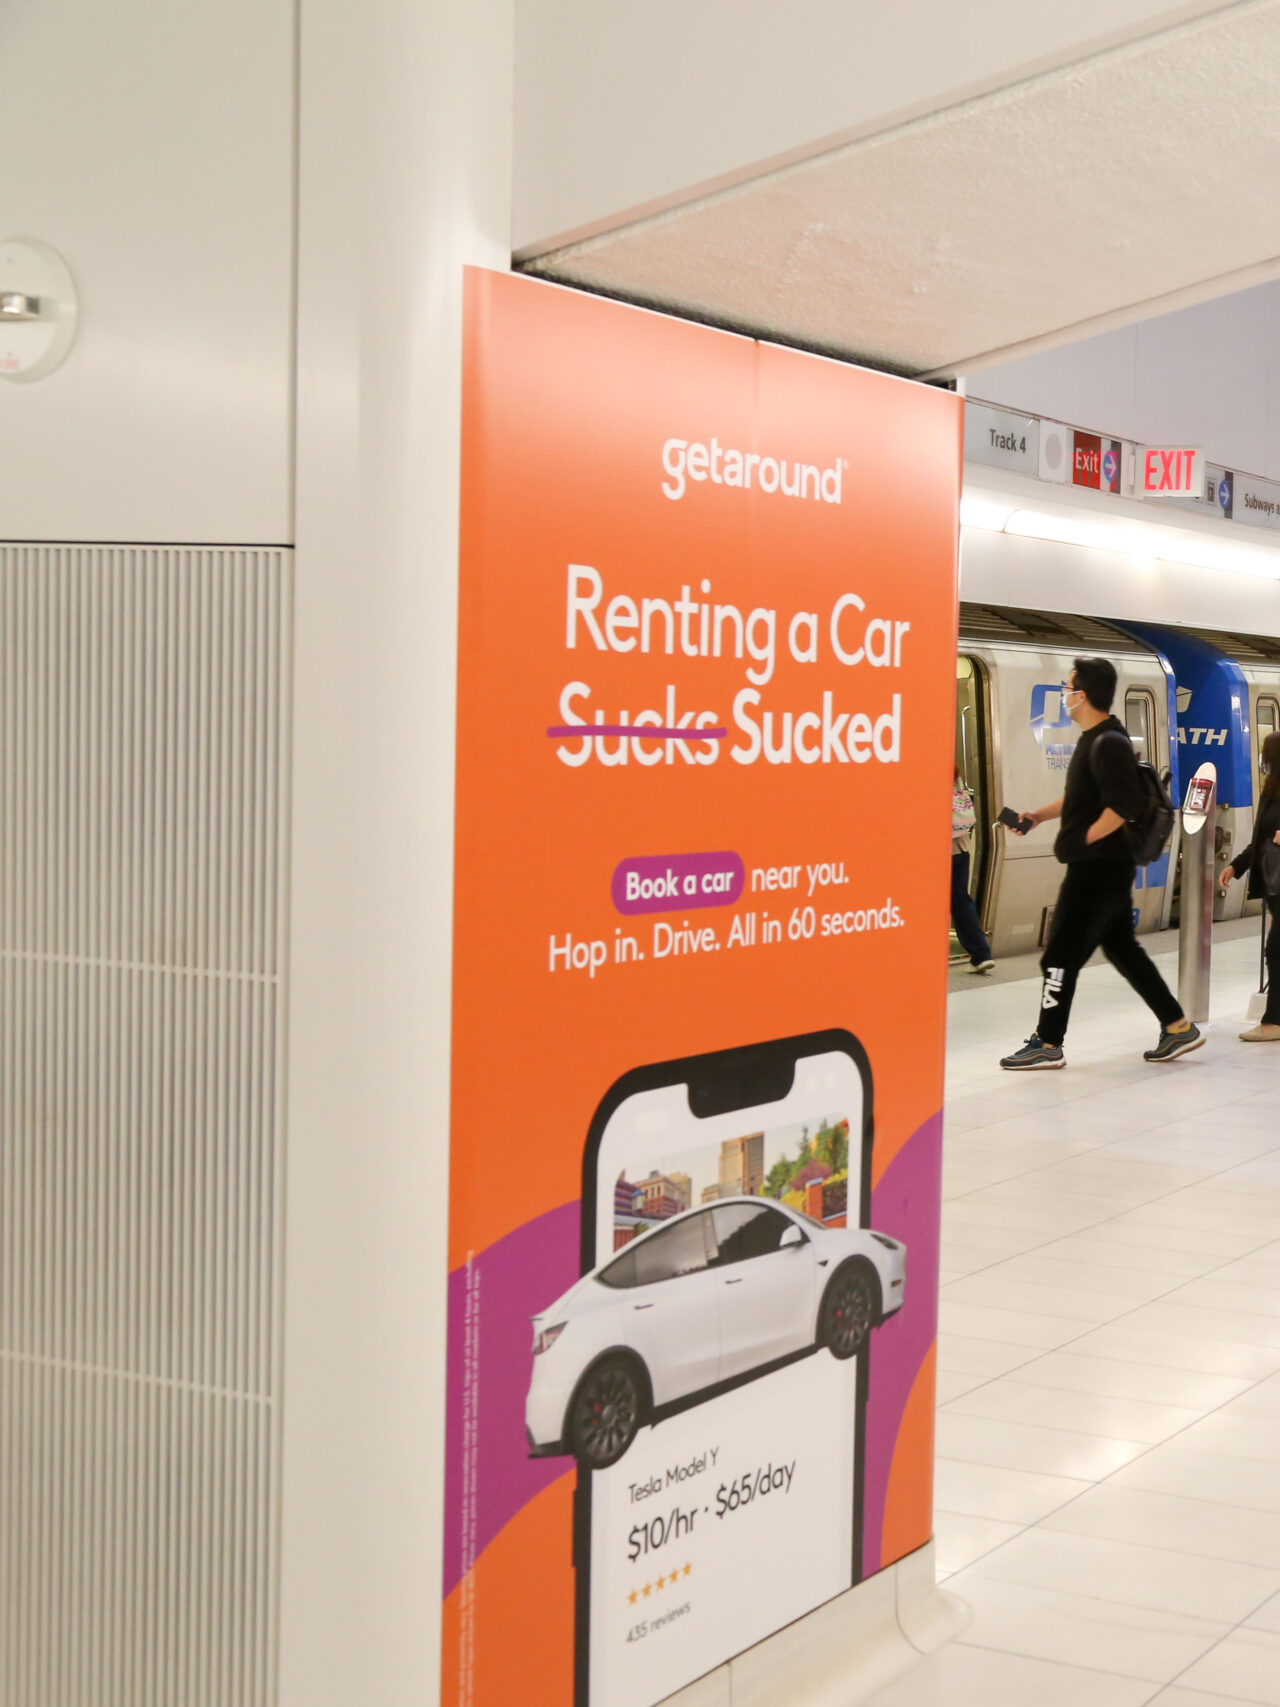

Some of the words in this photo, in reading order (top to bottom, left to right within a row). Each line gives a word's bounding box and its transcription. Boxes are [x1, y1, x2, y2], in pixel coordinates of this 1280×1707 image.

[989, 428, 1016, 452] Track
[1019, 438, 1027, 454] 4
[1074, 447, 1098, 473] Exit
[661, 438, 842, 504] getaround
[1144, 449, 1196, 491] EXIT
[1244, 493, 1274, 517] Subways
[566, 563, 776, 686] Renting
[788, 611, 818, 663] a
[830, 593, 911, 667] Car
[556, 681, 720, 768] Sucks
[730, 687, 901, 765] Sucked
[1176, 727, 1228, 746] ATH
[625, 869, 679, 901] Book
[683, 874, 697, 895] a
[701, 868, 734, 893] car
[751, 863, 801, 892] near
[806, 861, 850, 897] you.
[549, 933, 606, 978] Hop
[614, 927, 645, 964] in.
[653, 921, 721, 959] Drive.
[727, 912, 756, 949] All
[762, 913, 782, 944] in
[787, 905, 816, 941] 60
[821, 897, 905, 937] seconds.
[1042, 966, 1064, 1010] FILA
[628, 1474, 663, 1505] Tesla
[666, 1449, 707, 1489] Model
[709, 1445, 720, 1467] Y
[627, 1507, 698, 1564] $10/hr
[715, 1460, 797, 1521] $65/day
[625, 1621, 648, 1645] 435
[650, 1601, 691, 1634] reviews
